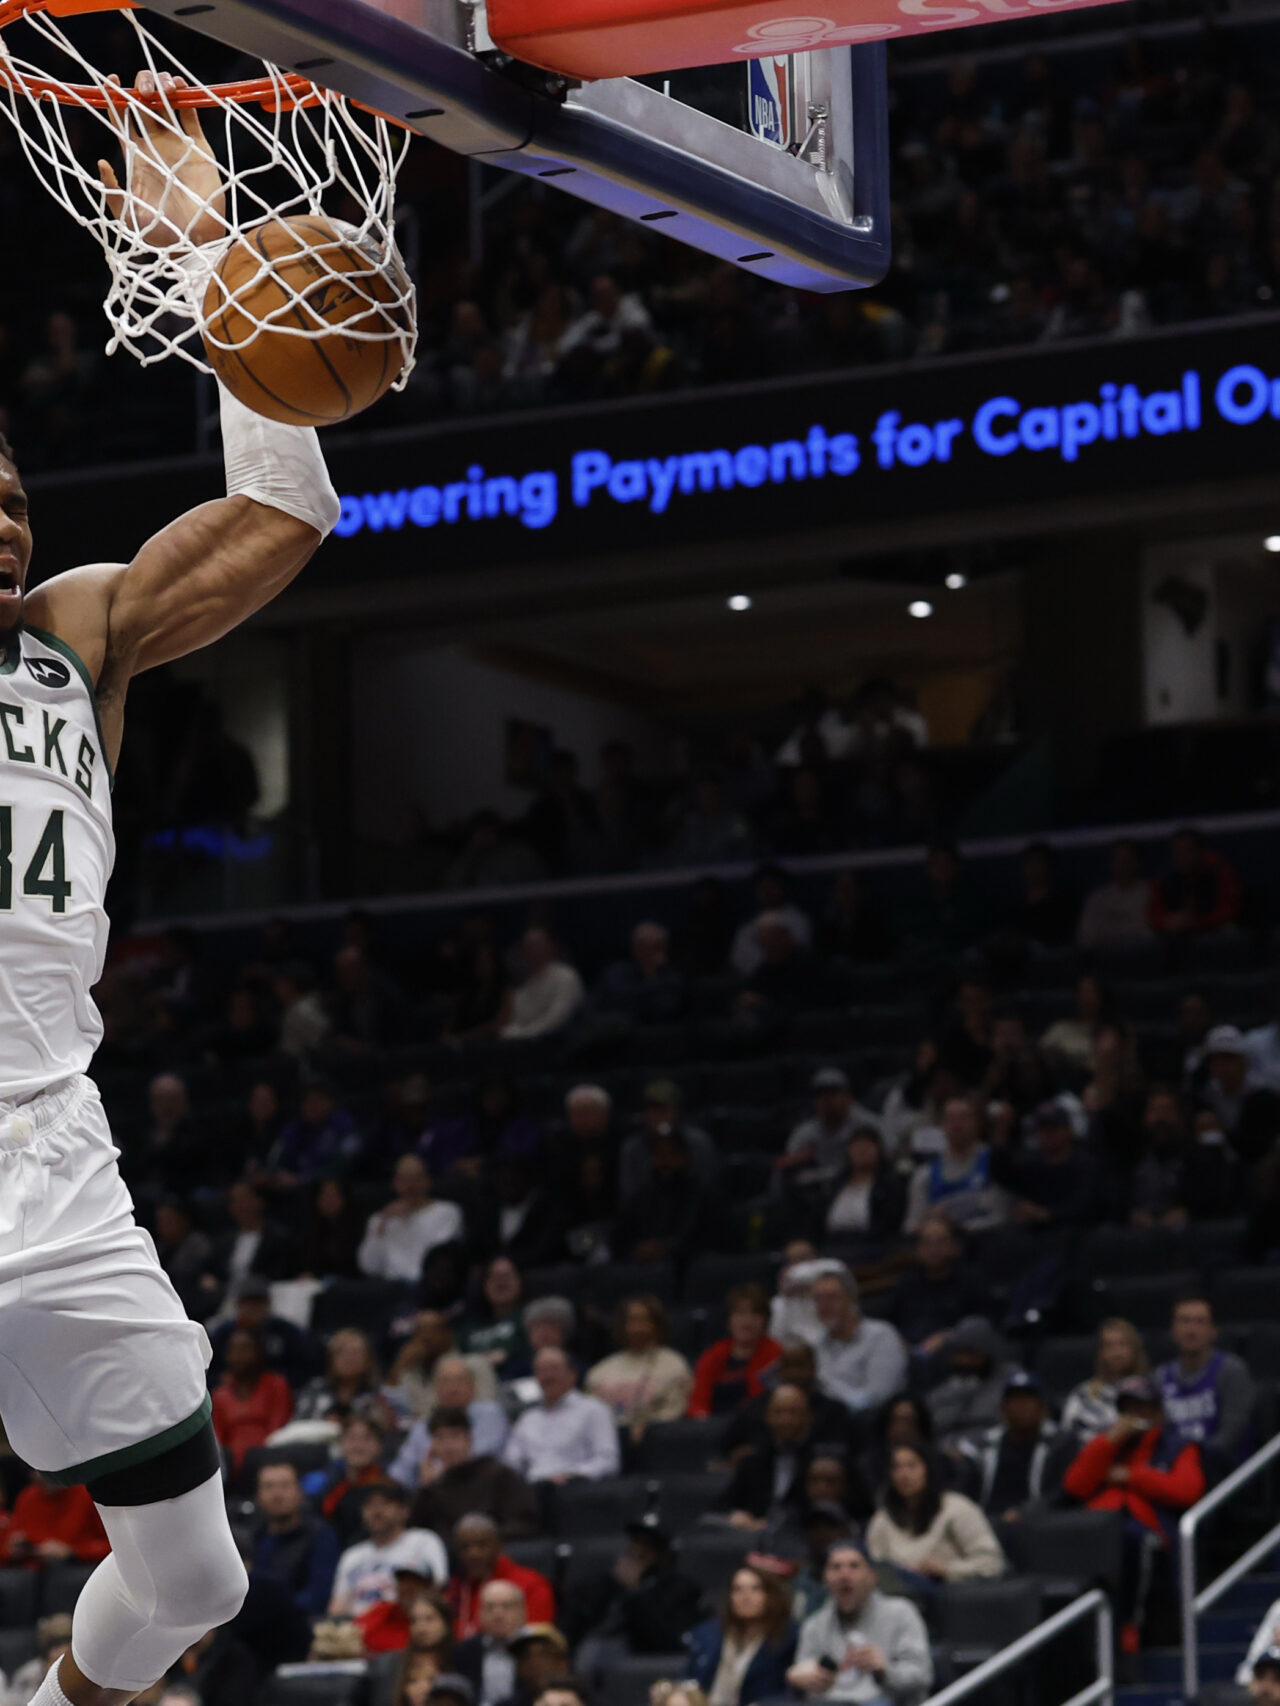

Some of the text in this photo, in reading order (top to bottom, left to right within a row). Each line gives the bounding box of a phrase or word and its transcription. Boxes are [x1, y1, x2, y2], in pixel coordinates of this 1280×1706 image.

[754, 94, 776, 132] NBA
[332, 464, 559, 538] owering
[570, 424, 861, 514] Payments
[871, 410, 965, 470] for
[971, 370, 1202, 462] Capital
